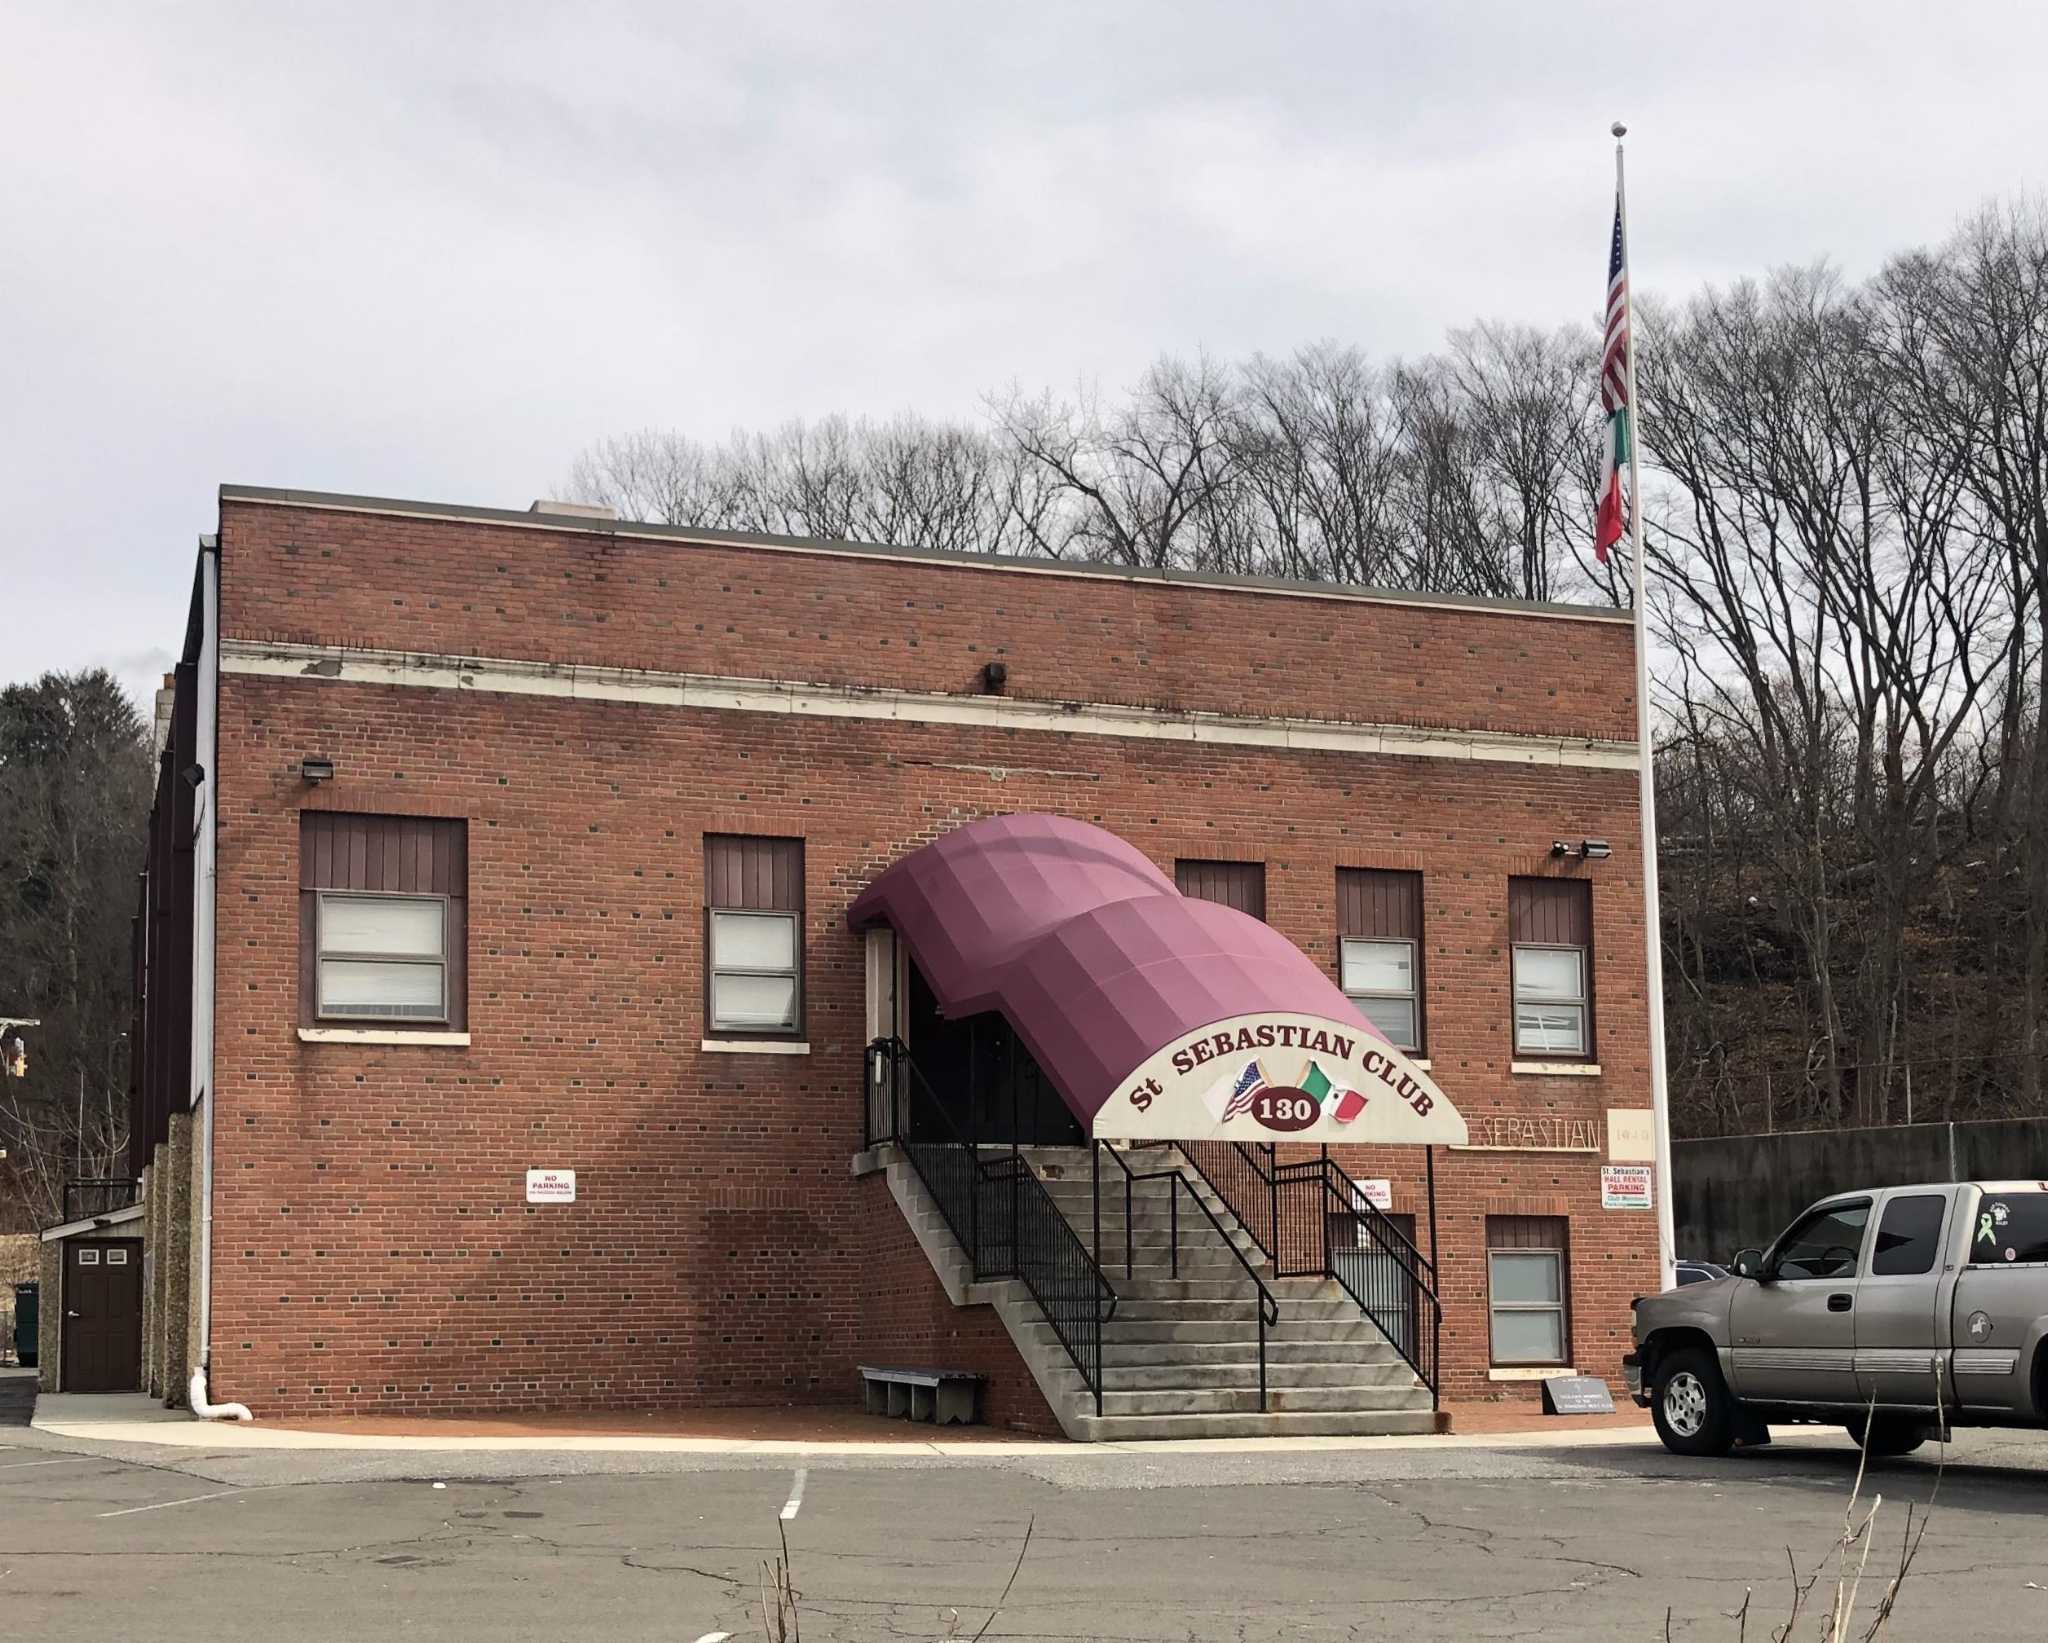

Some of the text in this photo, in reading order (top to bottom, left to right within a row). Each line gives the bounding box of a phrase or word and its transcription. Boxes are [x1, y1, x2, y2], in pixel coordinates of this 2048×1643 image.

[1130, 1025, 1435, 1117] St SEBASTIAN CLUB
[1258, 1097, 1312, 1120] 130
[1482, 1115, 1600, 1149] SEBASTIAN
[1607, 1183, 1645, 1191] PARKING
